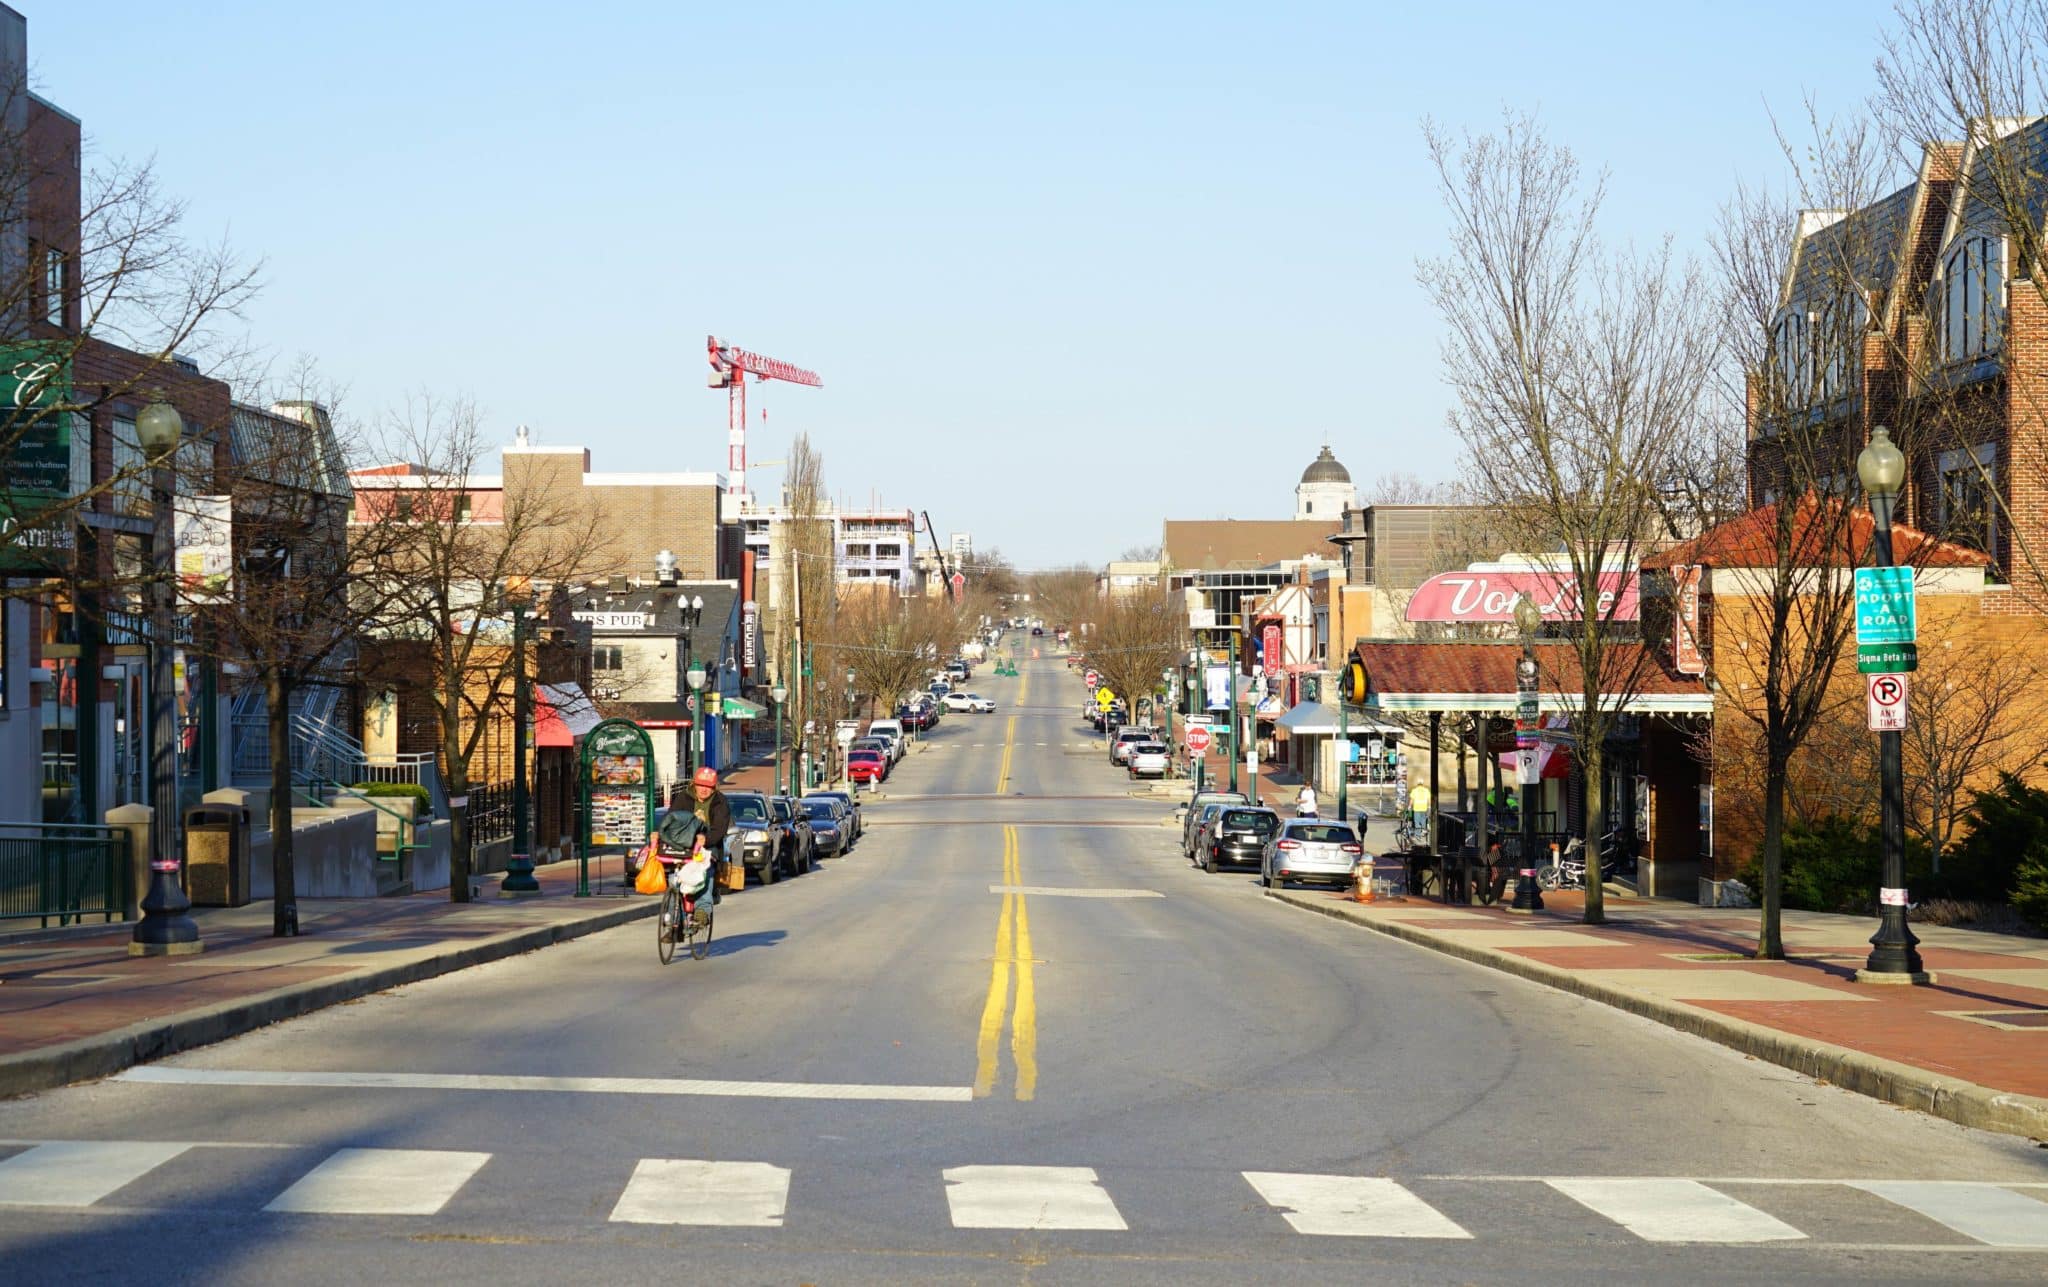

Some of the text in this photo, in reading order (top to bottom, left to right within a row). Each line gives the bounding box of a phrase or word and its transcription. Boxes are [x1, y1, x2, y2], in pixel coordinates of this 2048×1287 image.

[181, 532, 226, 546] BEAD
[1858, 592, 1912, 604] ADOPT
[611, 615, 641, 625] PUB
[1863, 615, 1908, 625] ROAD
[745, 615, 753, 664] RECESS
[1859, 654, 1880, 664] Sigma
[1883, 653, 1900, 661] Beta
[1520, 705, 1536, 713] BUS
[1880, 709, 1896, 717] ANY
[1880, 719, 1898, 727] TIME
[596, 734, 637, 751] Bloomington
[1188, 734, 1209, 744] STOP
